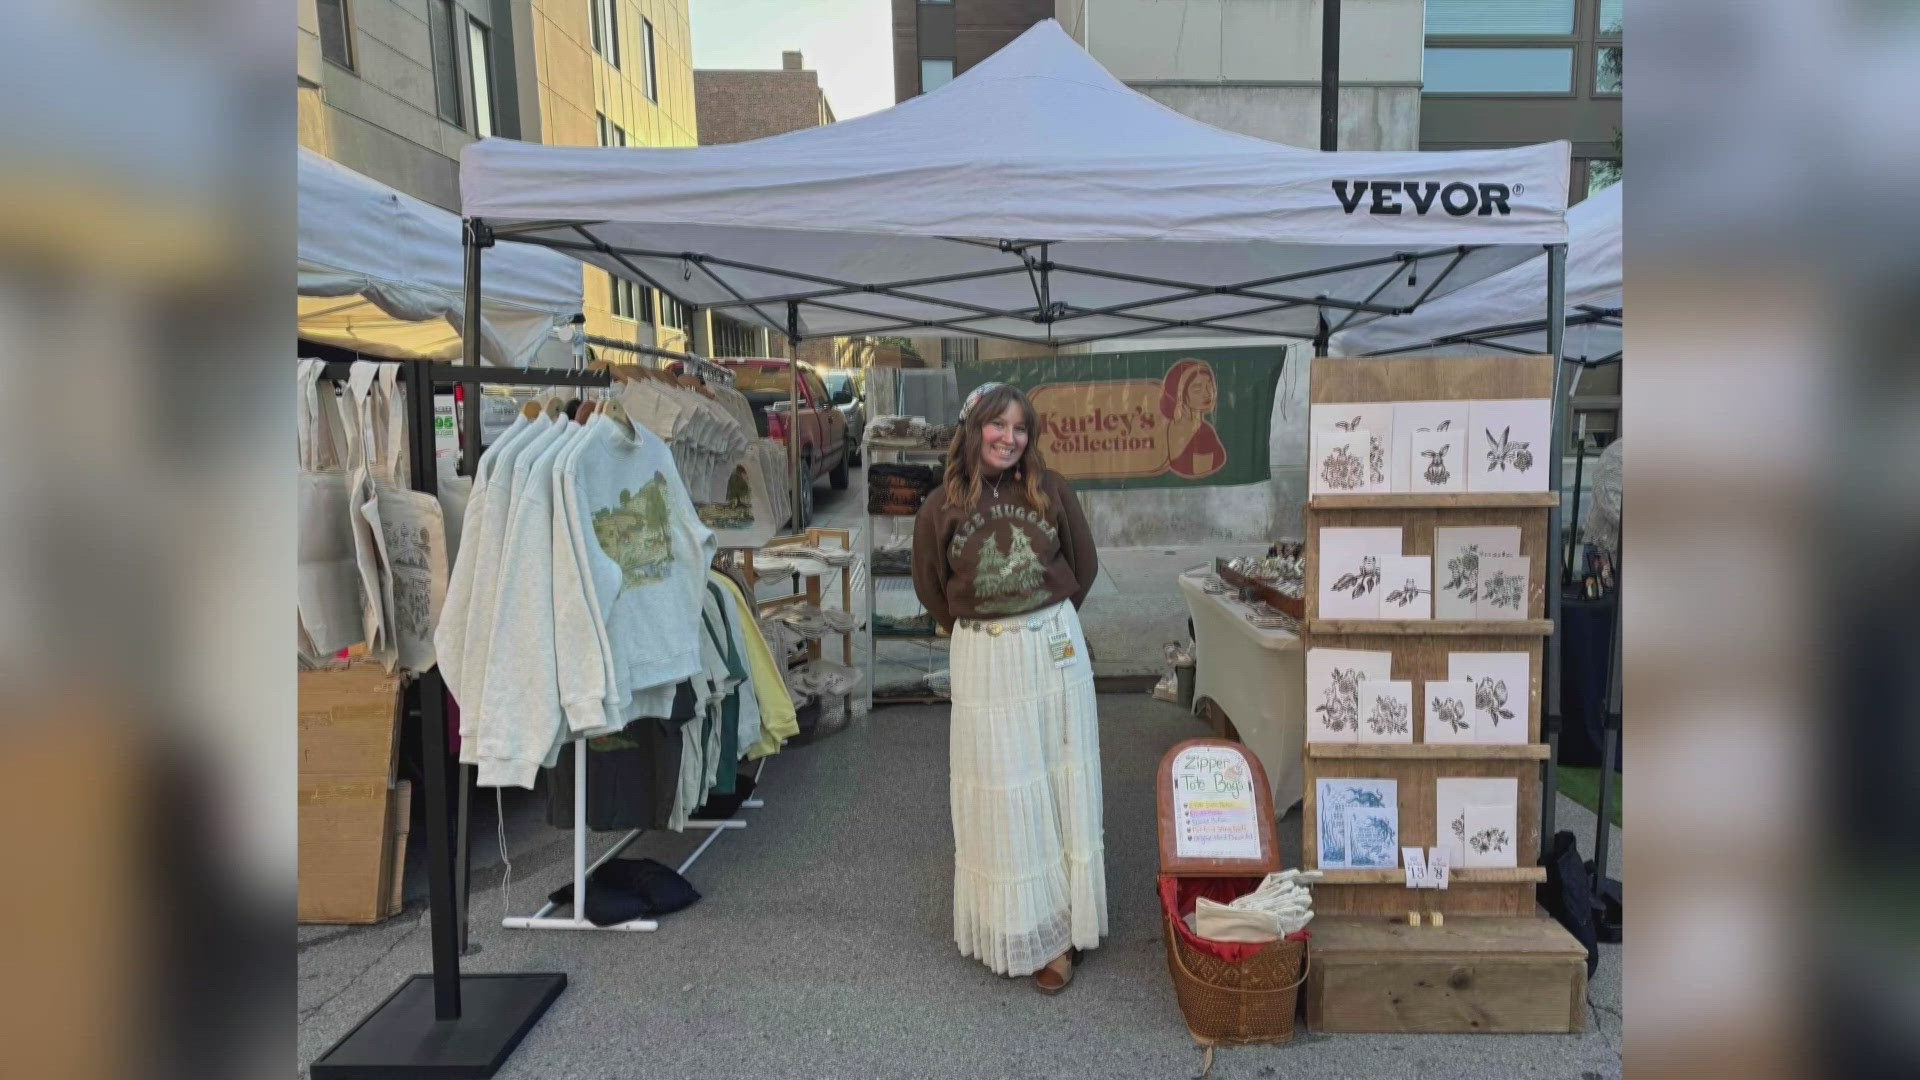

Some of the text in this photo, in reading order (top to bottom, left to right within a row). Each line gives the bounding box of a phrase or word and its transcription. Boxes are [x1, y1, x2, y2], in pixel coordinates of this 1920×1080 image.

[1039, 405, 1155, 439] Karley's
[1050, 430, 1154, 453] collection
[1183, 754, 1231, 774] Zipper
[1180, 772, 1244, 799] Tote Bags
